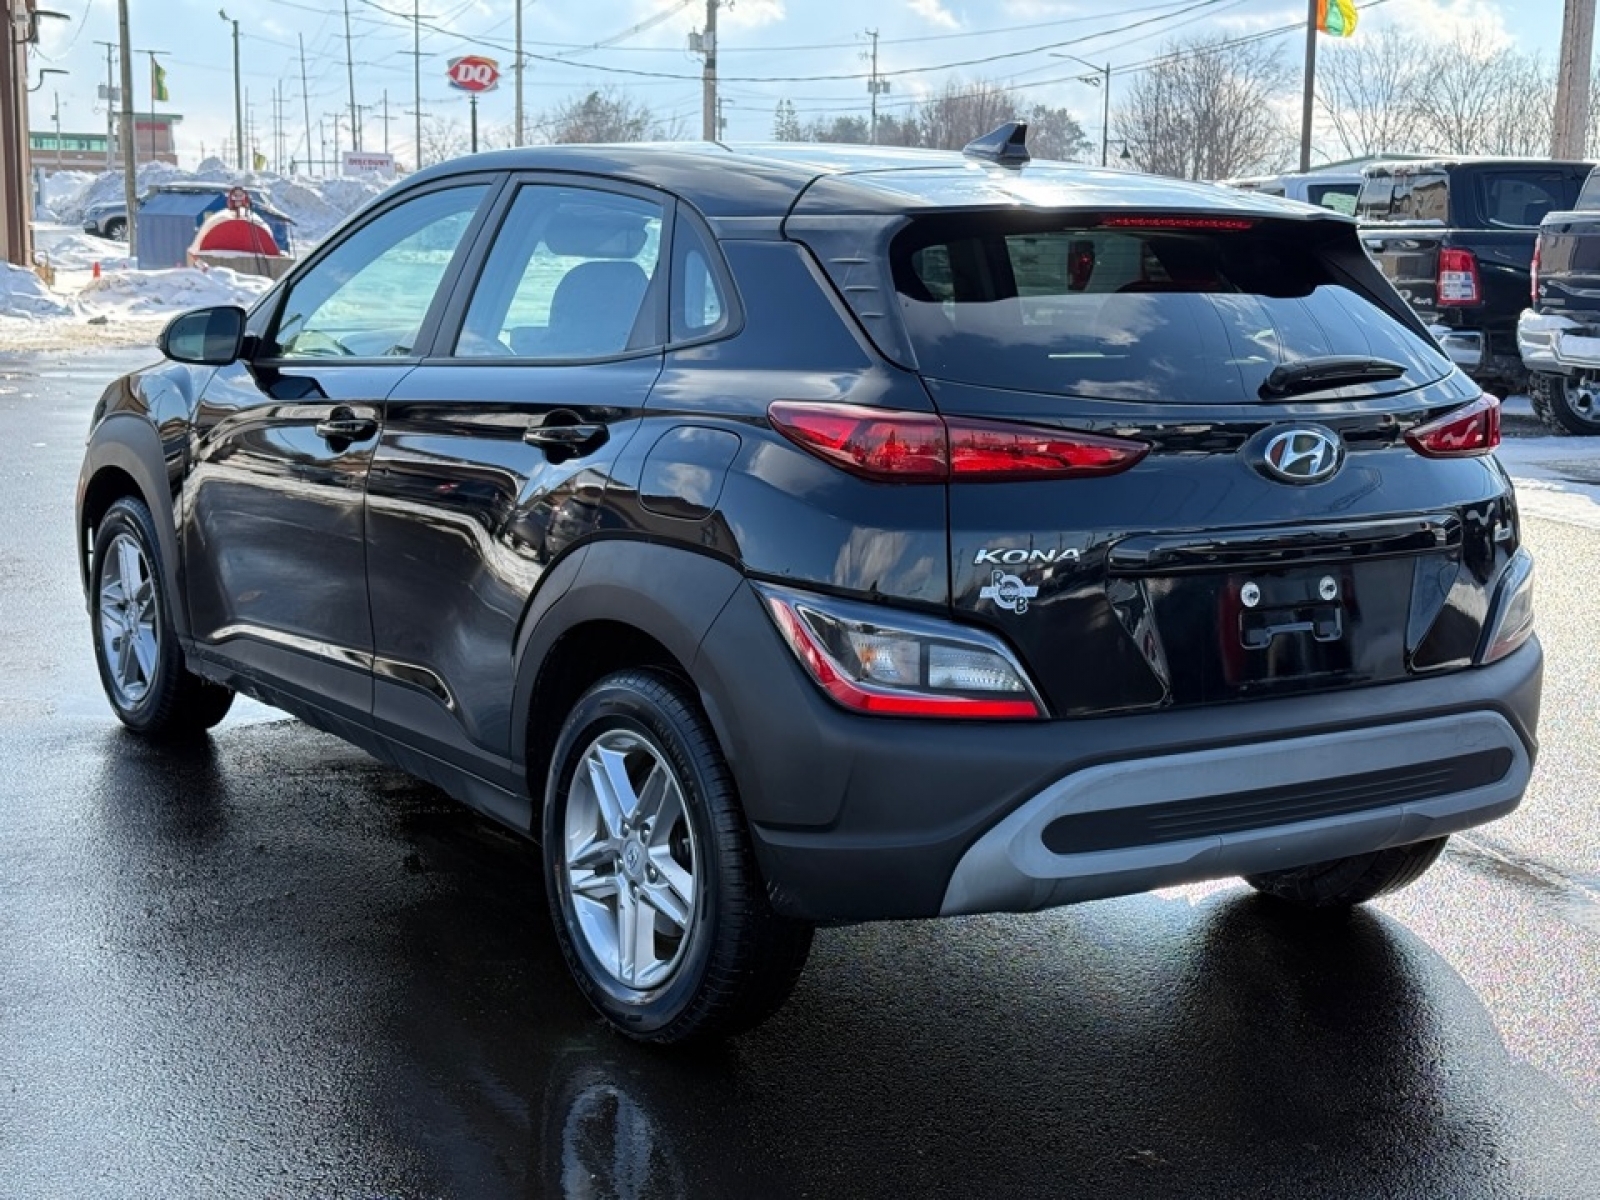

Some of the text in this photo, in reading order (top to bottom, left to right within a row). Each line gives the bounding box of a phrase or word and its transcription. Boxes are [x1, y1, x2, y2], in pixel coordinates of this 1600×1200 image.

[458, 64, 492, 86] DQ
[347, 158, 389, 167] DISCOUNT
[974, 548, 1081, 564] KONA
